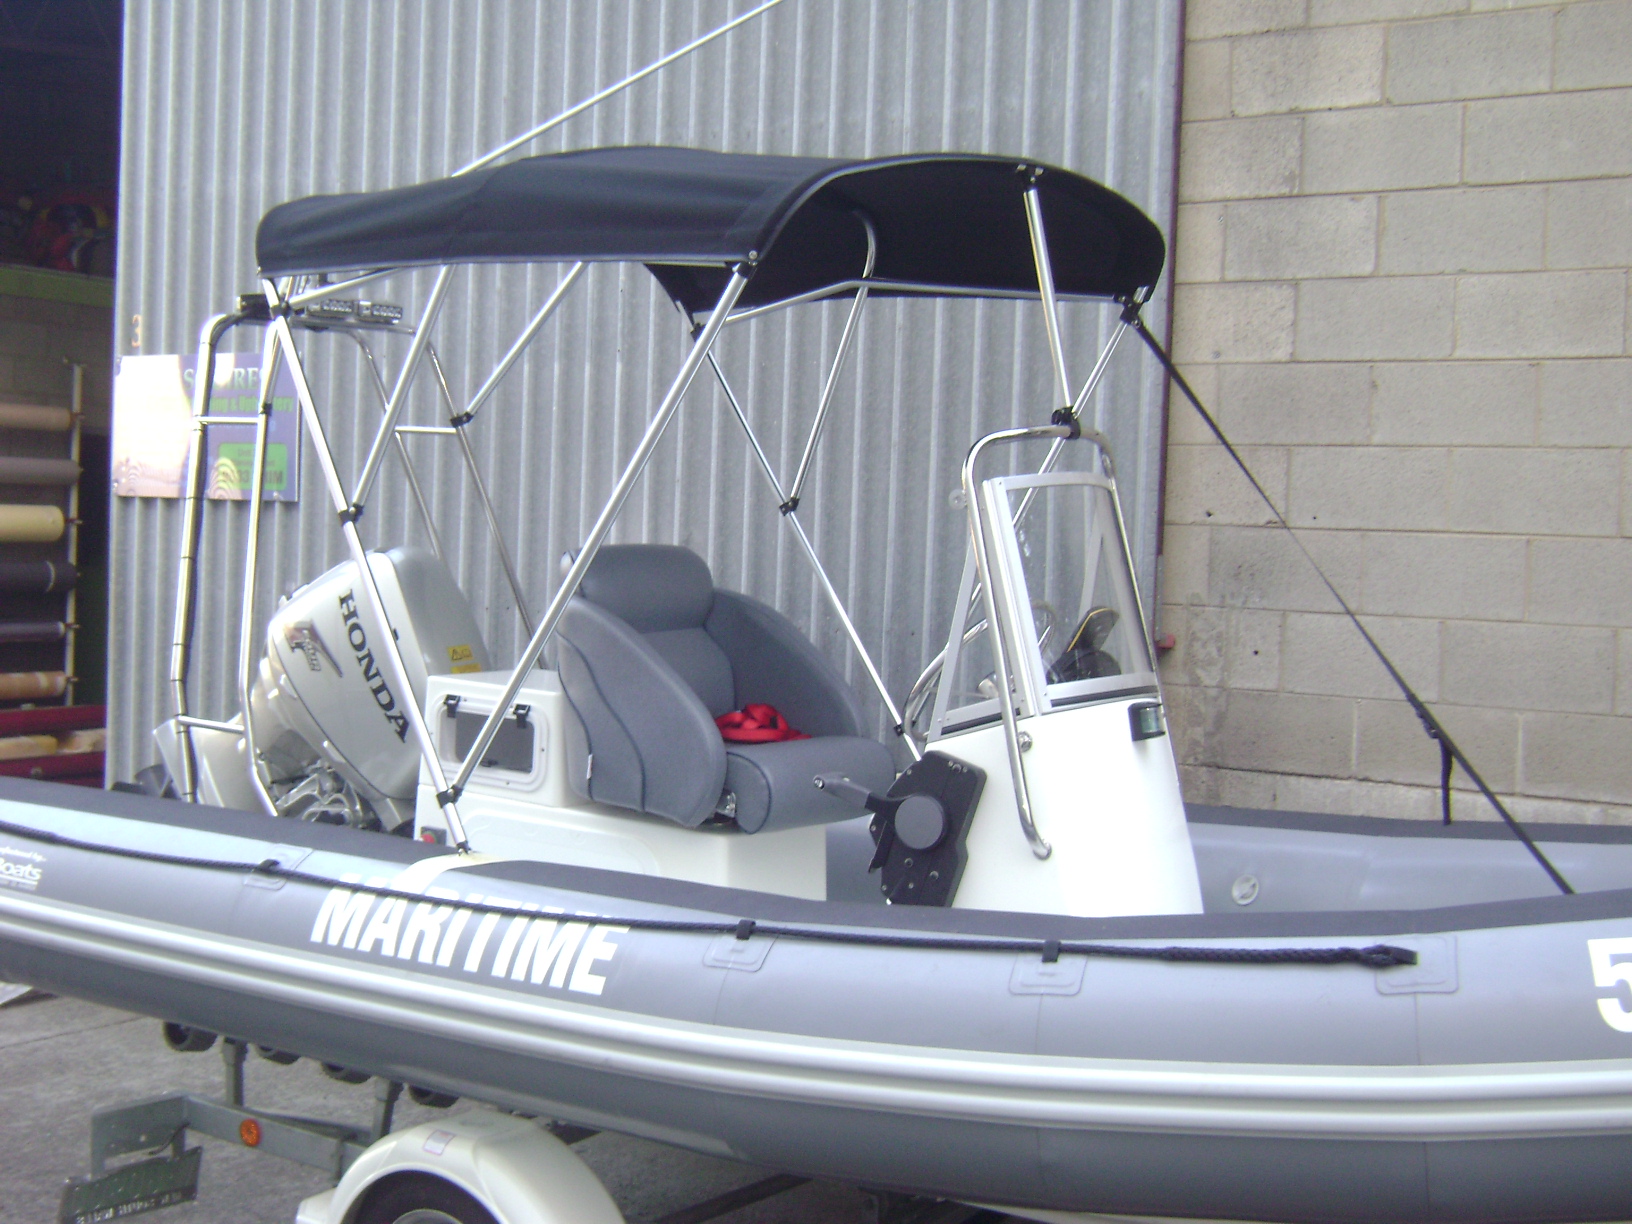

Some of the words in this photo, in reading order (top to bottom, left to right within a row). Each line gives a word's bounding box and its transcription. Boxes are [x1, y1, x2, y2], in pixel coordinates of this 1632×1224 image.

[131, 314, 143, 348] 3
[339, 589, 410, 743] HONDA
[310, 872, 630, 996] MARITIME
[1587, 937, 1632, 1032] 5
